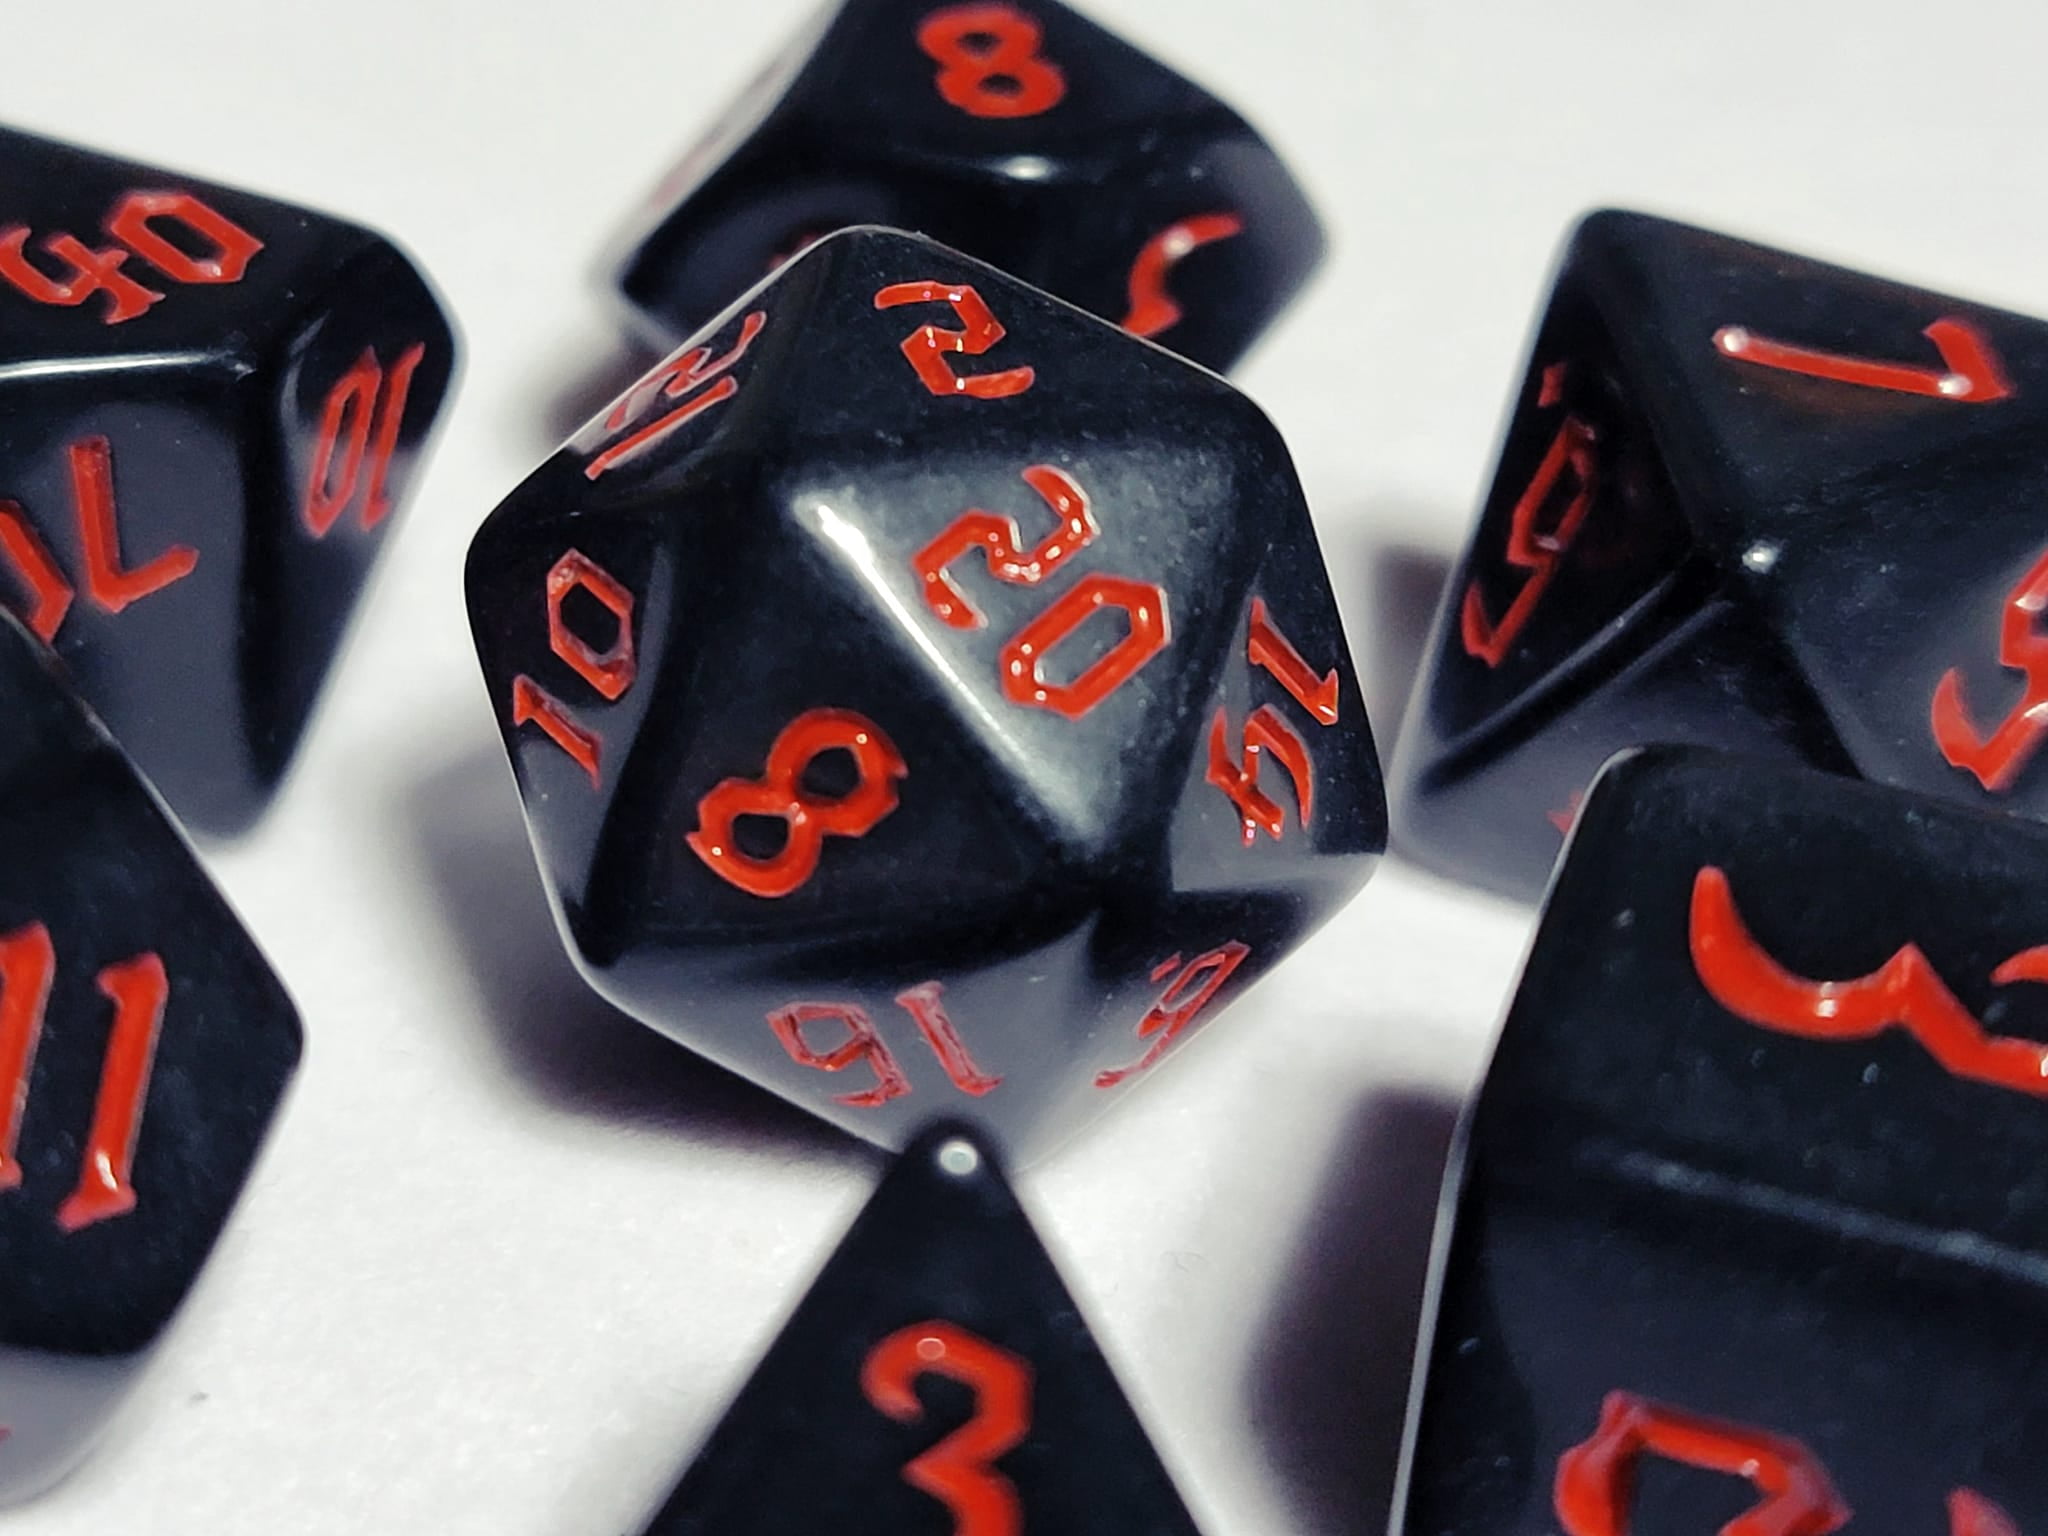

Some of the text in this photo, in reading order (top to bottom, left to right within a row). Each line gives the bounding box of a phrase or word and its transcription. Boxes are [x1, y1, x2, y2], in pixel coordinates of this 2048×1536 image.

[916, 2, 1068, 120] 8
[0, 189, 265, 326] 40
[872, 279, 1036, 400] 2
[302, 343, 426, 537] 10
[511, 550, 636, 787] 10
[909, 464, 1171, 723] 20
[684, 707, 909, 900] 8
[1205, 596, 1340, 848] 14
[766, 980, 1003, 1109] 16
